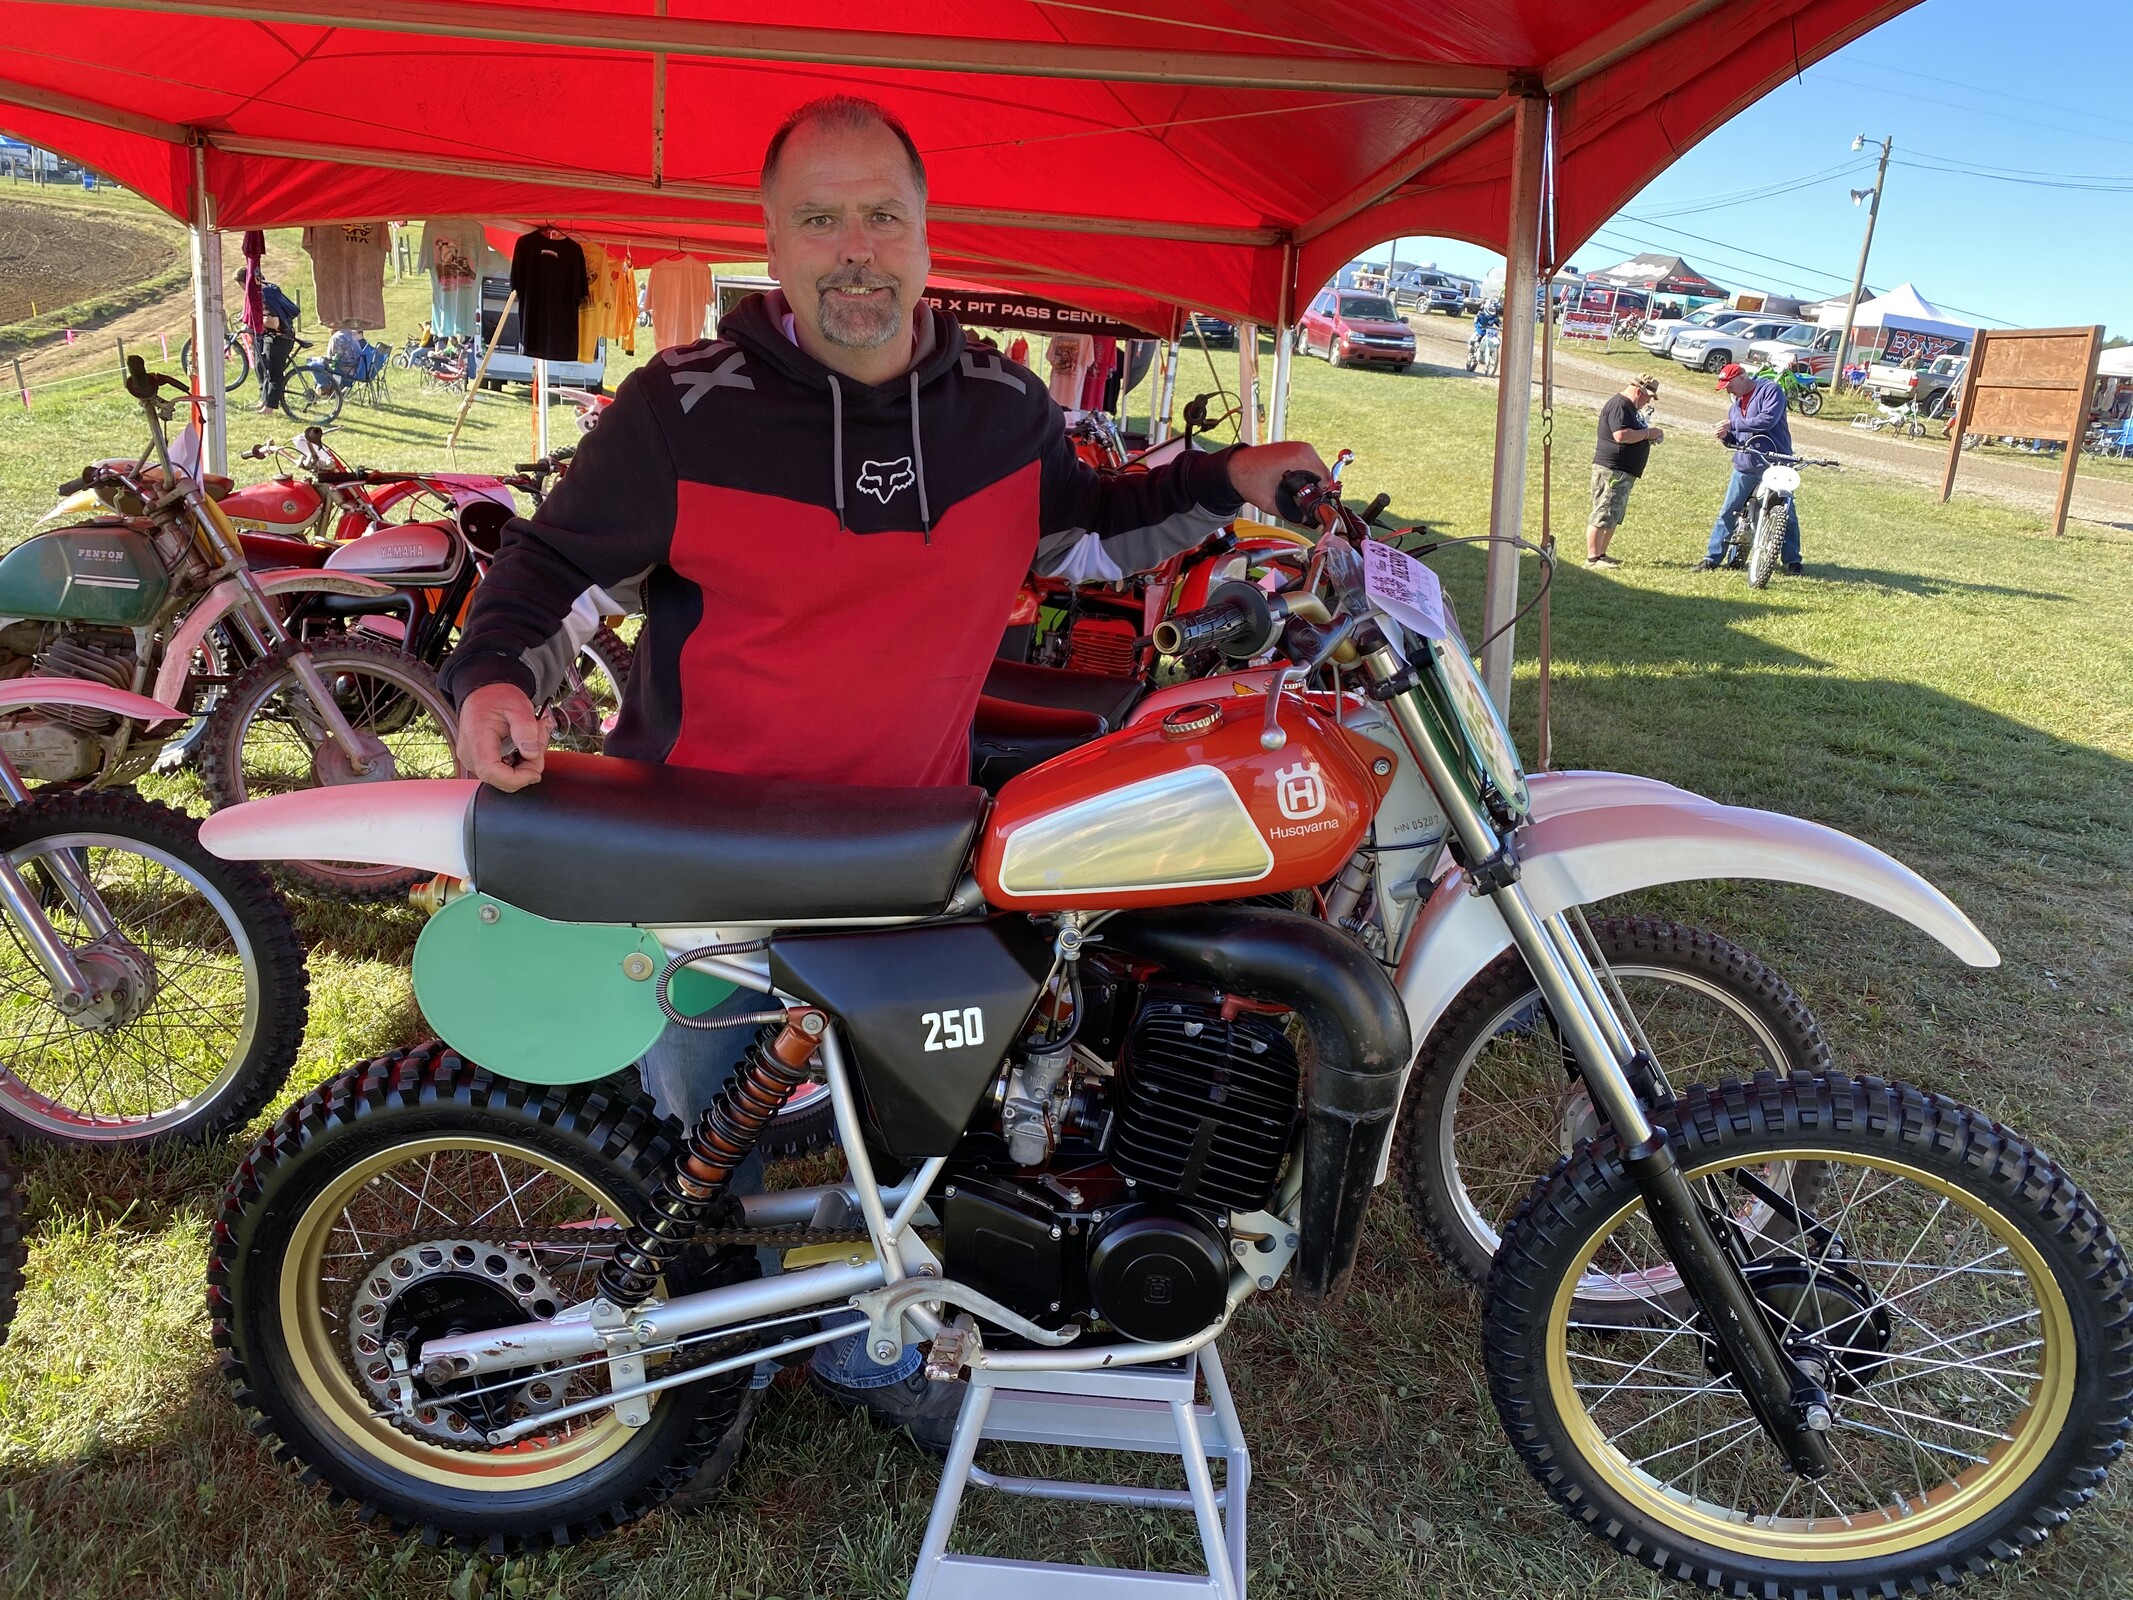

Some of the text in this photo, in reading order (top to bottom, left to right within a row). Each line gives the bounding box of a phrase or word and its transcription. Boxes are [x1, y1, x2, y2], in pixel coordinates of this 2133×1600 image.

[948, 300, 962, 311] X
[967, 301, 996, 314] PIT
[1001, 304, 1051, 319] PASS
[1056, 309, 1121, 325] CENT
[78, 549, 124, 559] PENTON
[381, 544, 424, 559] YAMAHA
[1269, 818, 1339, 840] Husqvarna
[921, 1006, 985, 1052] 250
